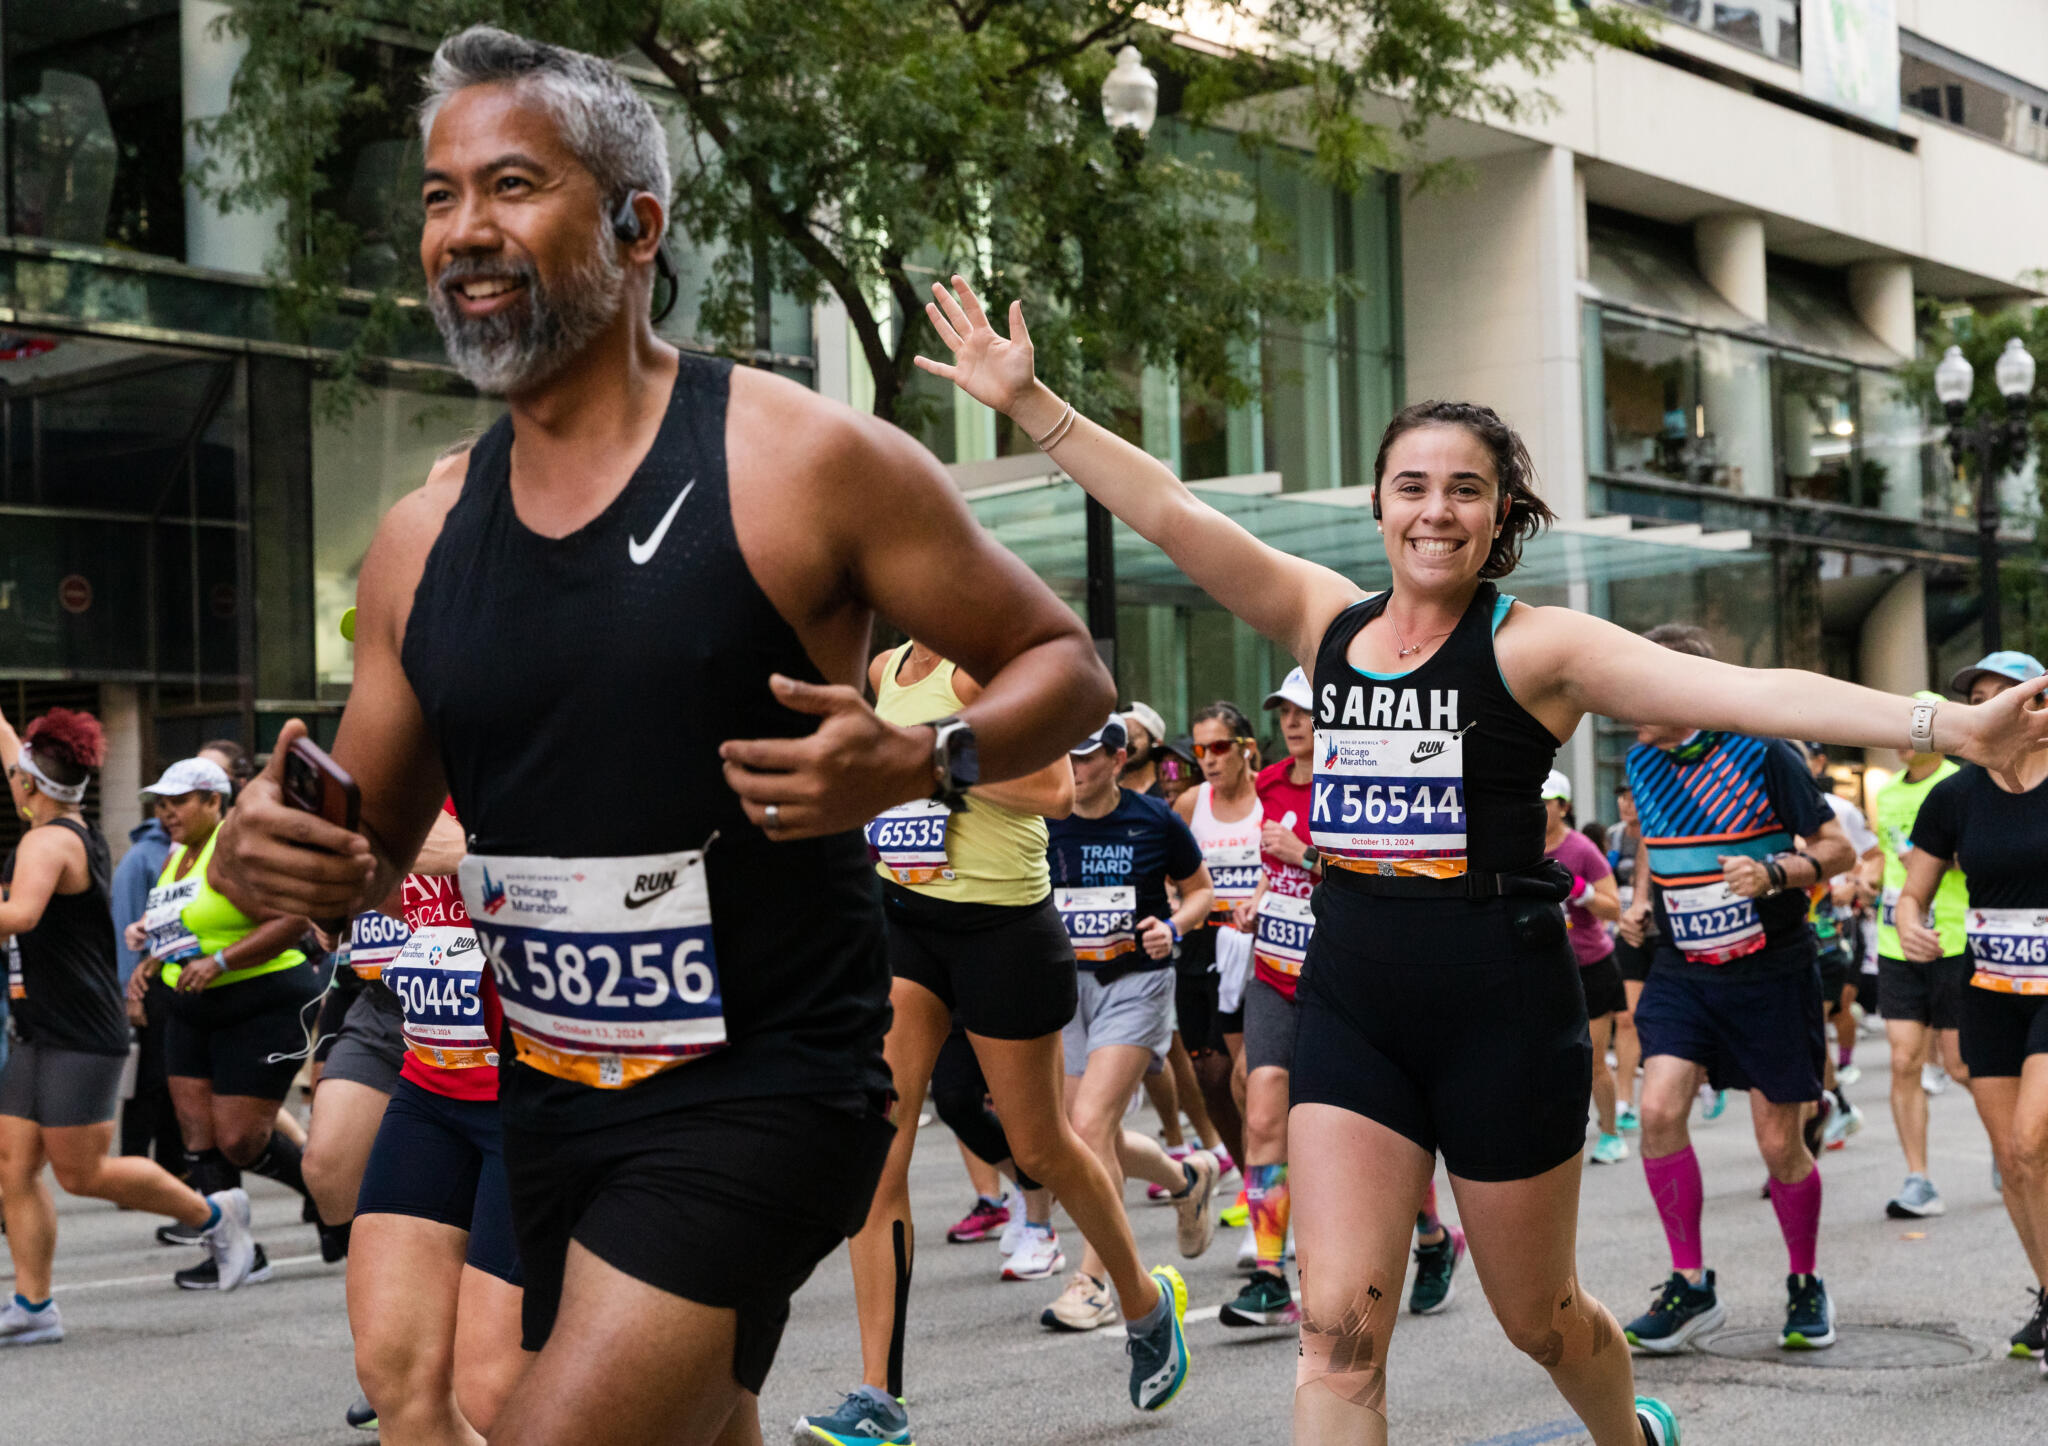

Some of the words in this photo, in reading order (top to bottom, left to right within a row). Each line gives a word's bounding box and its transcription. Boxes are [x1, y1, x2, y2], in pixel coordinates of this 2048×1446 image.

[1320, 683, 1459, 730] SARAH
[1340, 747, 1369, 758] Chicago
[1417, 741, 1445, 754] RUN
[1340, 757, 1377, 766] Marathon
[1312, 782, 1335, 822] K
[1341, 784, 1463, 824] 56544
[878, 819, 945, 847] 65535
[1352, 838, 1379, 846] October
[1394, 838, 1415, 846] 2024
[1080, 845, 1134, 860] TRAIN
[1081, 860, 1132, 875] HARD
[508, 883, 558, 903] Chicago
[635, 870, 678, 893] RUN
[361, 915, 409, 943] 6609
[1074, 912, 1133, 935] 62583
[1669, 916, 1687, 938] H
[1689, 902, 1752, 936] 42227
[454, 937, 478, 949] RUN
[1968, 936, 1987, 959] K
[1989, 936, 2048, 963] 5246
[479, 931, 521, 993] K
[523, 938, 714, 1008] 58256
[396, 975, 480, 1016] 50445
[553, 1022, 593, 1037] October
[616, 1028, 645, 1039] 2024
